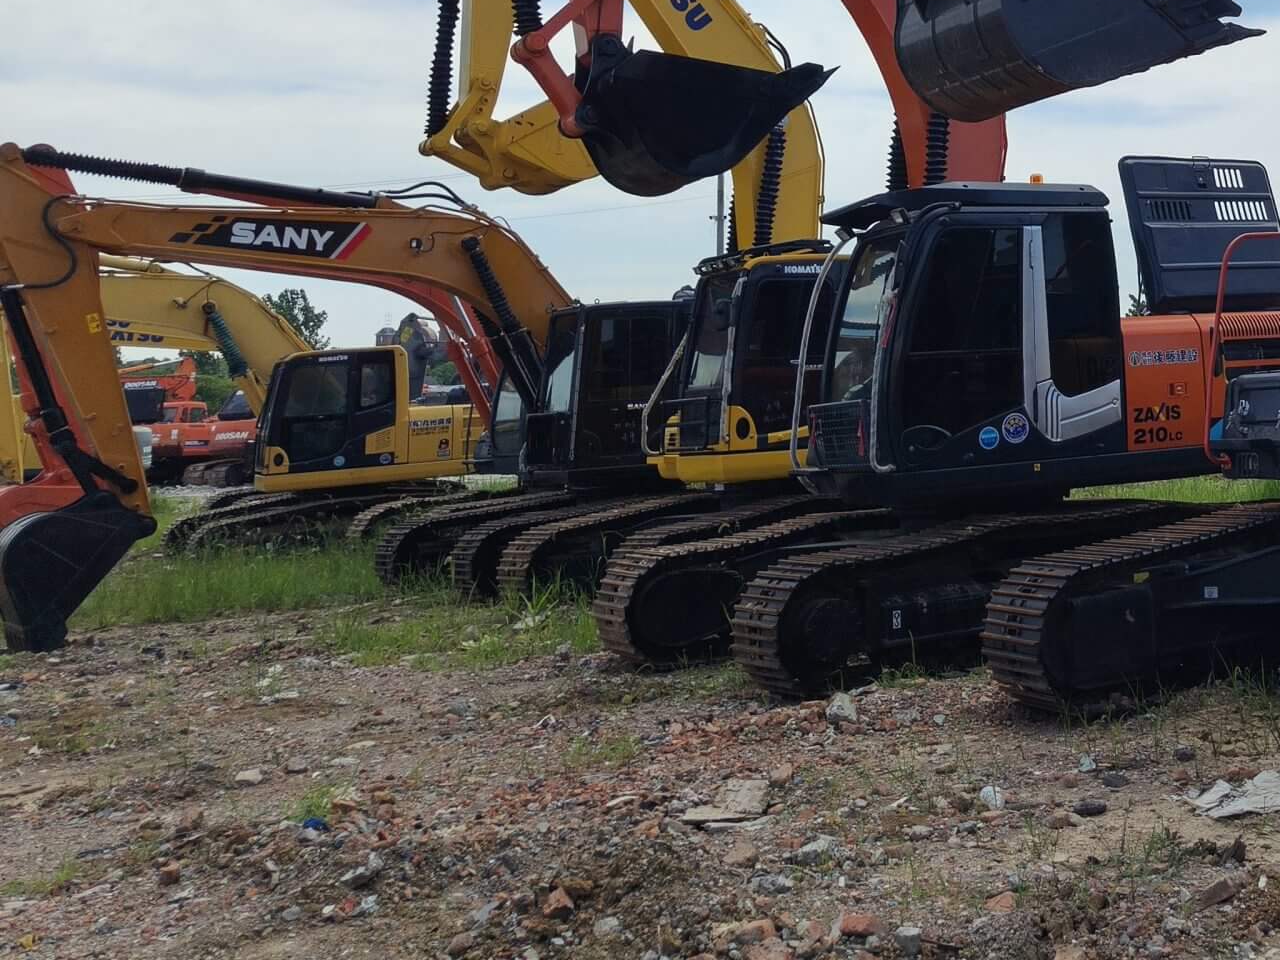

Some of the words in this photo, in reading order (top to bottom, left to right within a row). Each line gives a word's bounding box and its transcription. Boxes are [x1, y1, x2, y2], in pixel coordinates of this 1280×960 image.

[230, 222, 335, 251] SANY
[784, 264, 825, 274] KOMATS
[1134, 402, 1181, 423] ZAXIS
